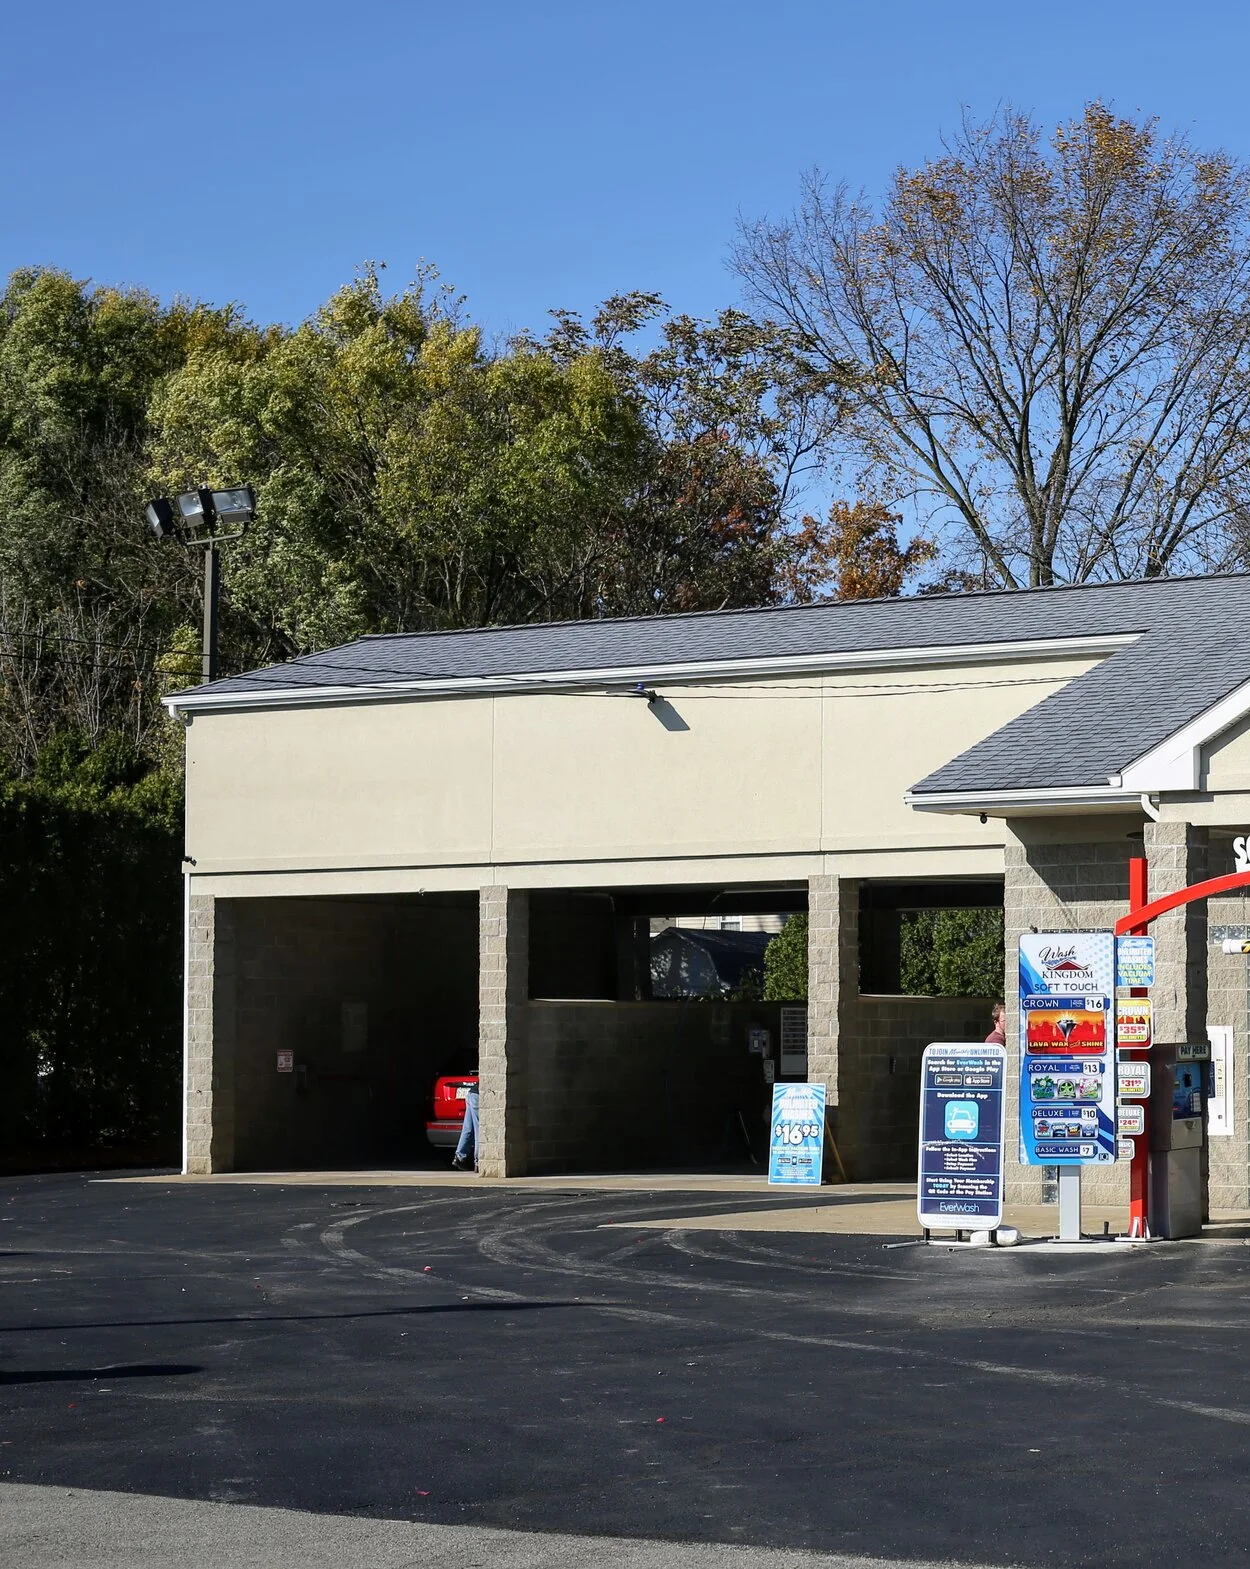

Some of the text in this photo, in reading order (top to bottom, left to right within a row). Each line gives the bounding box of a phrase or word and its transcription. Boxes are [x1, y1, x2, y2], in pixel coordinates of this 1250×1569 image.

[1039, 945, 1075, 962] Wash
[1042, 970, 1093, 979] KINGDOM
[1034, 983, 1098, 991] SOFT TOUCH
[1023, 999, 1059, 1008] CROWN
[1086, 999, 1102, 1009] $16
[1180, 1045, 1207, 1055] PAY HERE
[1028, 1064, 1060, 1072] ROYAL
[1084, 1064, 1097, 1073] $13
[1118, 1065, 1146, 1075] ROYAL
[1083, 1110, 1096, 1118] $10
[940, 1202, 980, 1212] EverWash
